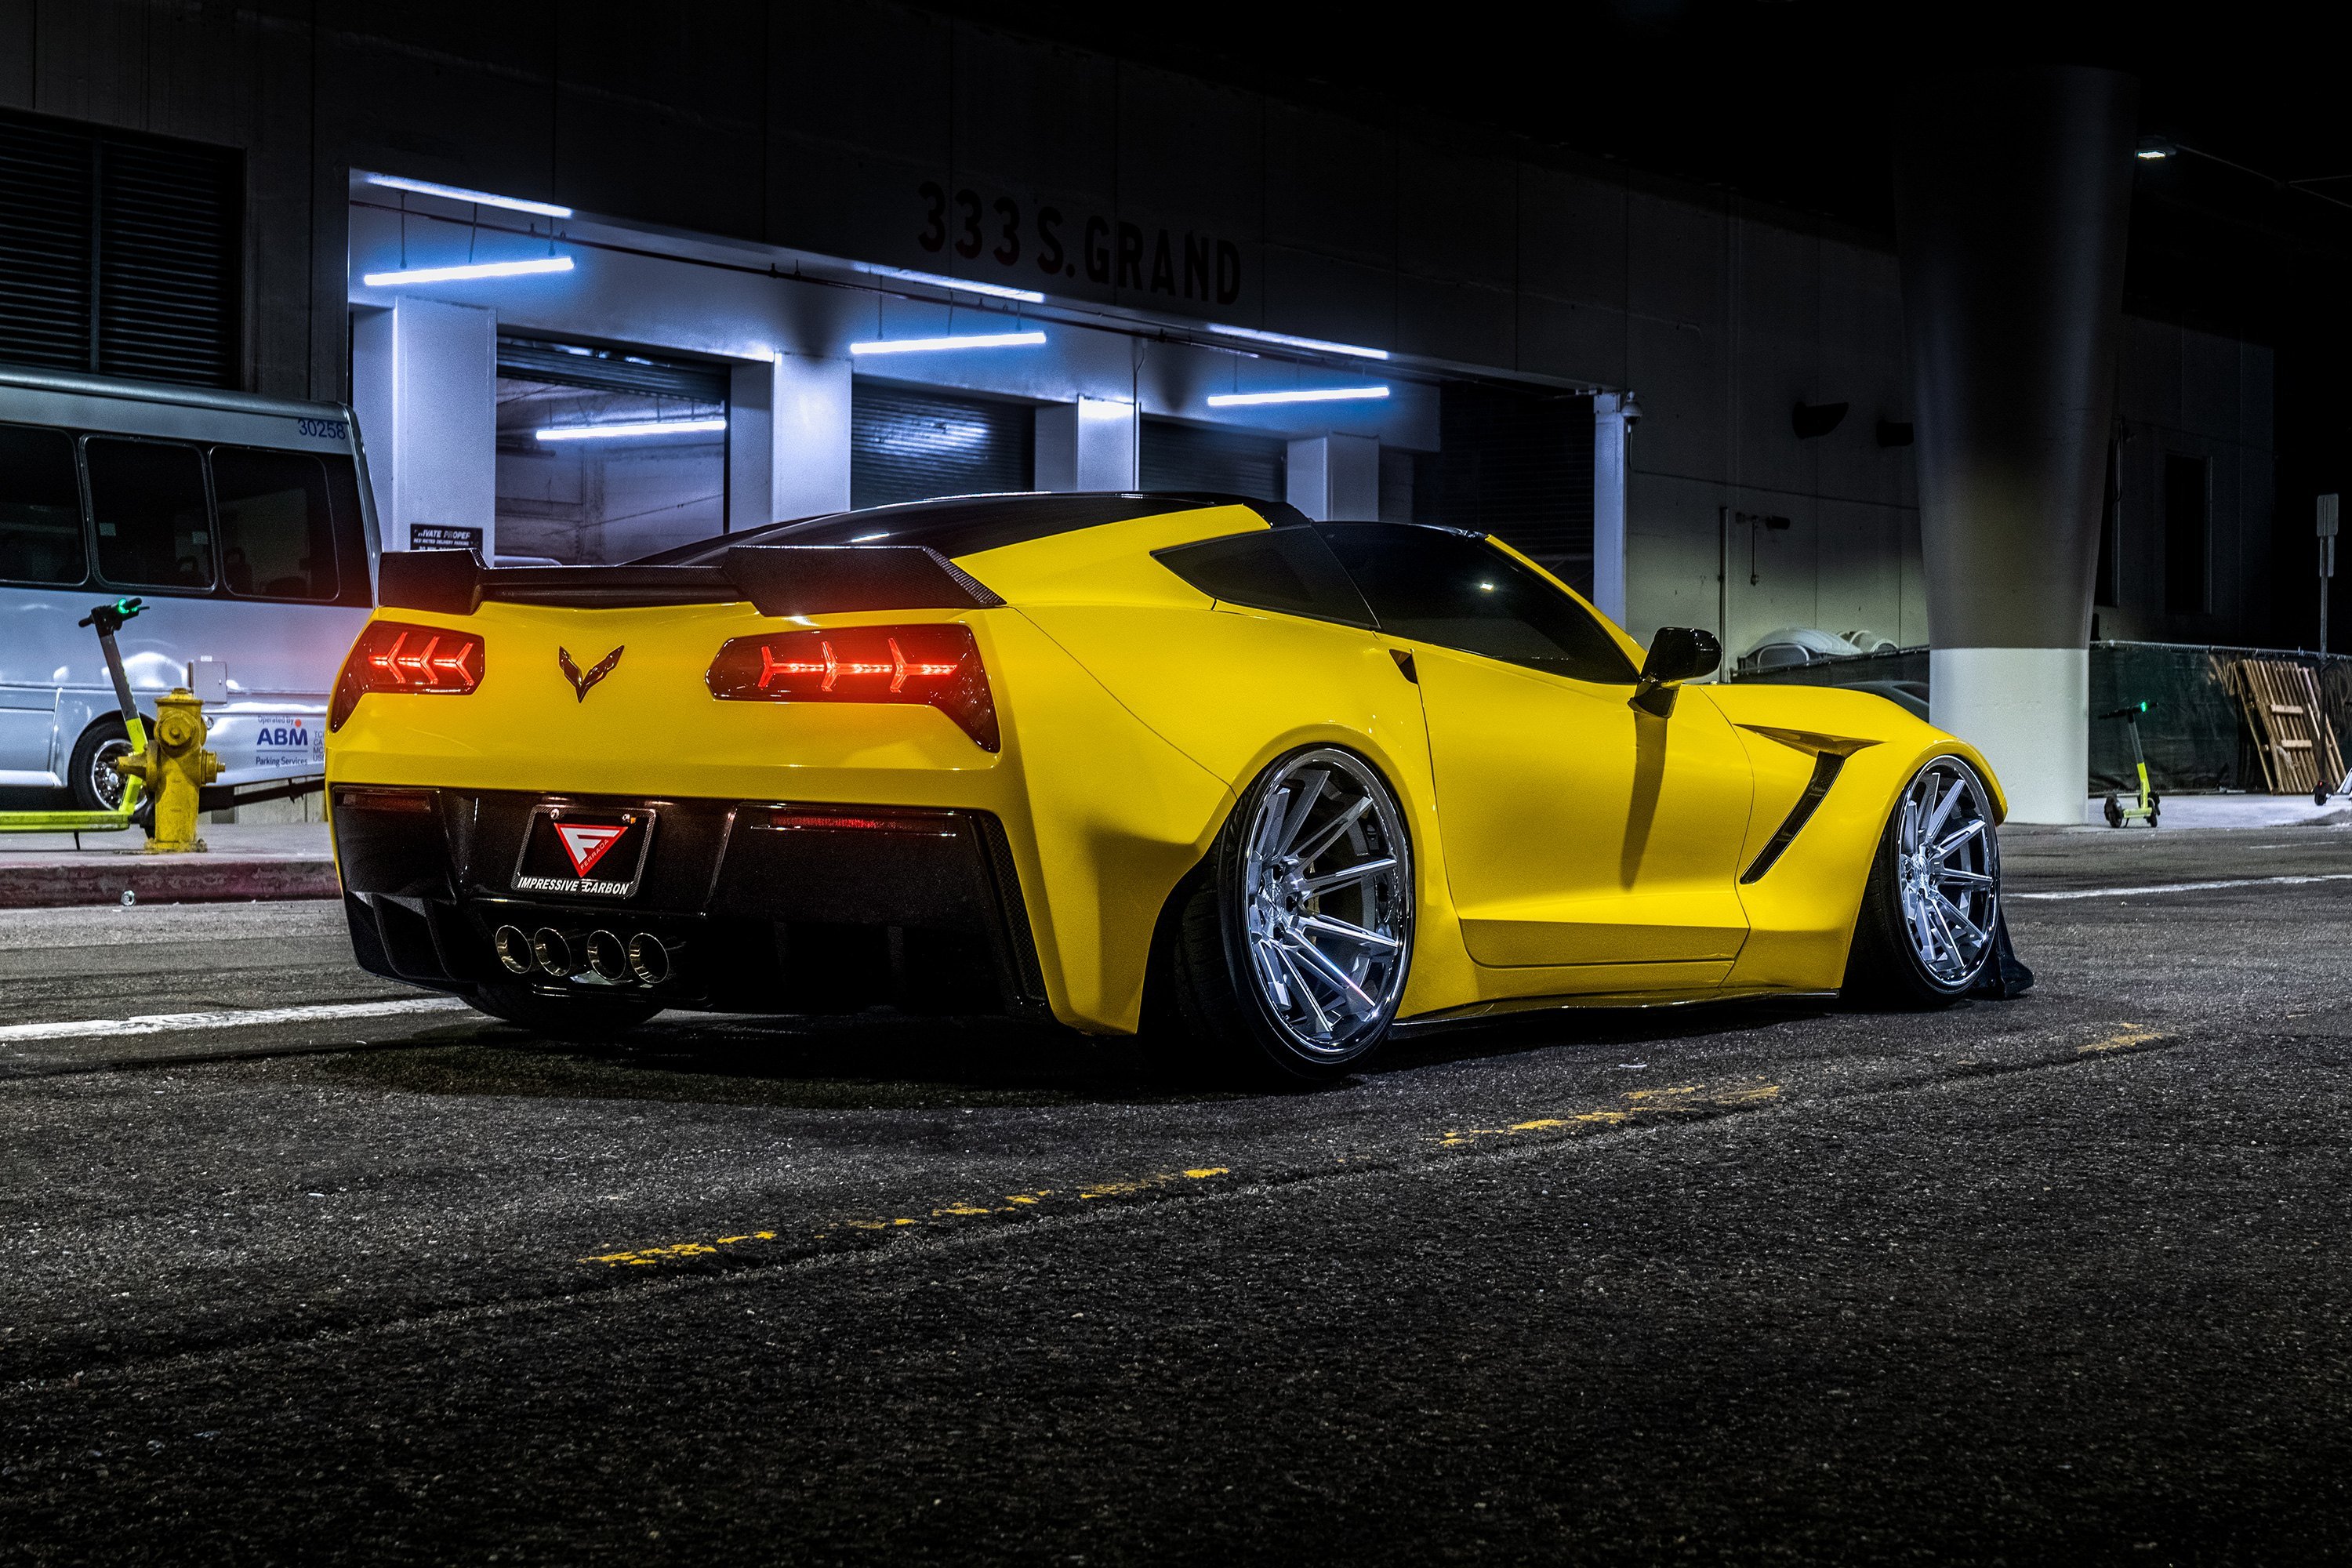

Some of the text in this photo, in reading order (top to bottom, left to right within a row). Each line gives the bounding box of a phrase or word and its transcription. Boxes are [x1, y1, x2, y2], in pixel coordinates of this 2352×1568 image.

[918, 181, 1020, 266] 333
[298, 419, 346, 440] 30258
[414, 529, 442, 539] IVATE
[258, 715, 295, 726] Operated By
[256, 728, 308, 746] ABM
[256, 757, 308, 768] Parking Services
[580, 838, 610, 871] FERRADA
[517, 876, 630, 895] IMPRESSIVE CARBON
